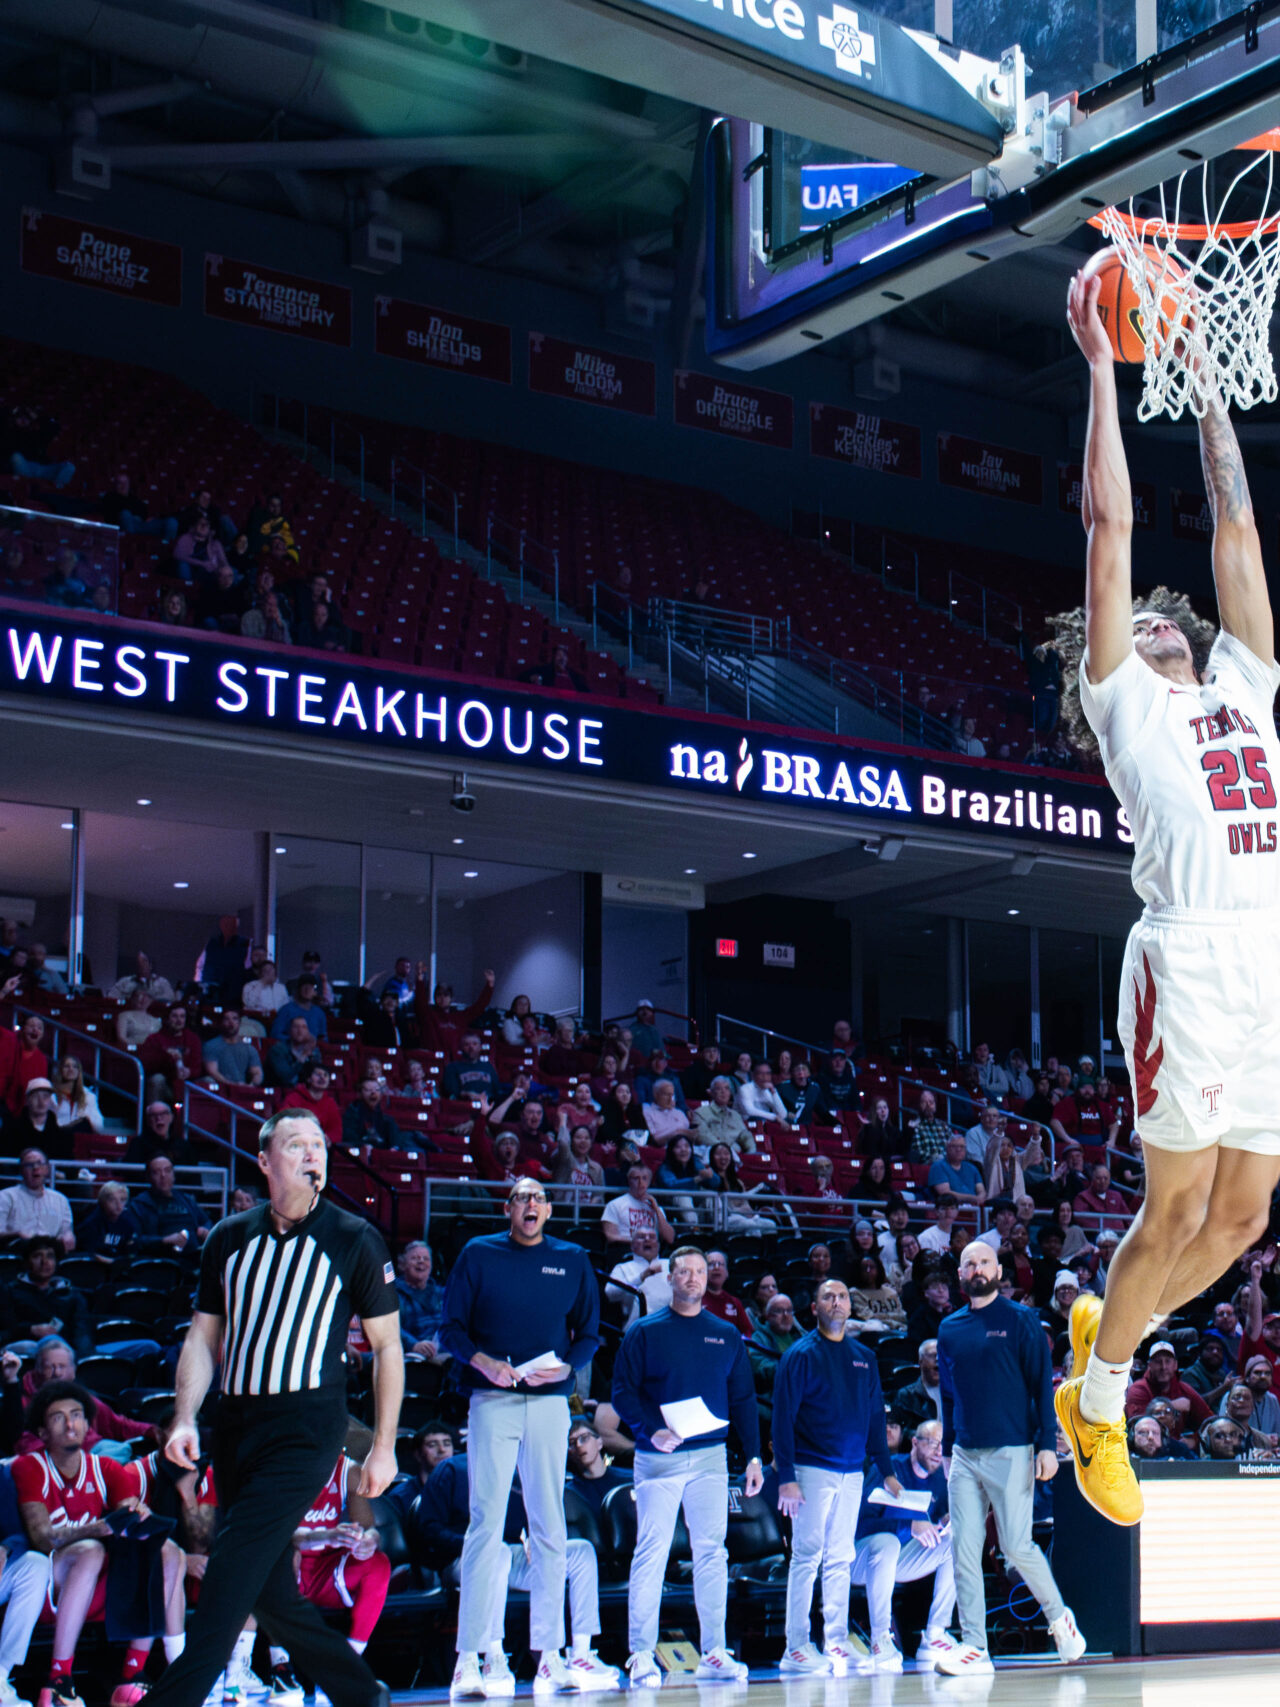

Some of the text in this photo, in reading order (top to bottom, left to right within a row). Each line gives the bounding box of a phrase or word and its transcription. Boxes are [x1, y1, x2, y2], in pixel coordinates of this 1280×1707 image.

[79, 231, 131, 262] Pepe
[56, 245, 149, 284] SANCHEZ
[242, 271, 321, 308] Terence
[223, 286, 336, 328] STANSBURY
[428, 316, 463, 341] Don
[406, 330, 483, 363] SHIELDS
[573, 351, 616, 377] Mike
[564, 367, 623, 396] BLOOM
[695, 398, 774, 432] DRYSDALE
[713, 385, 760, 413] Bruce
[855, 412, 881, 435] Bill
[834, 439, 901, 467] KENNEDY
[960, 461, 1021, 489] NORMAN
[8, 628, 604, 766] WEST STEAKHOUSE
[1189, 704, 1260, 744] TEML
[670, 742, 912, 812] na BRASA
[1201, 746, 1277, 811] 25
[923, 775, 1102, 839] Brazilian
[1228, 821, 1277, 856] OWLS
[304, 1502, 339, 1523] wls
